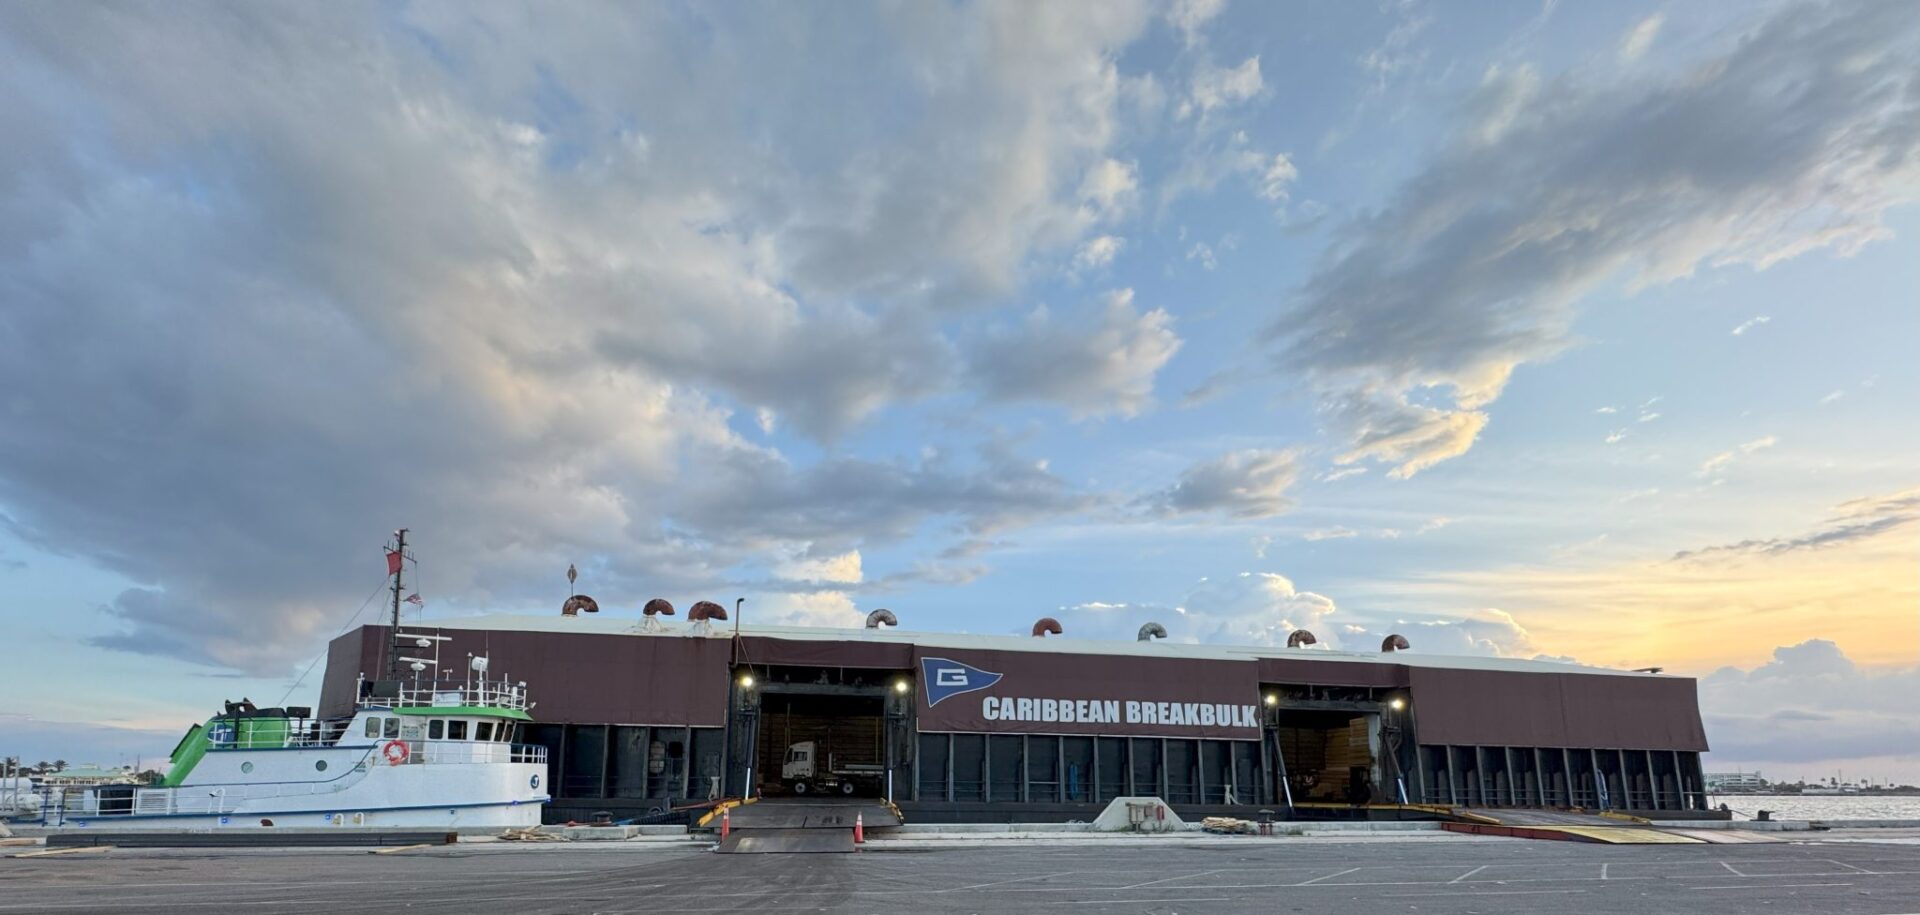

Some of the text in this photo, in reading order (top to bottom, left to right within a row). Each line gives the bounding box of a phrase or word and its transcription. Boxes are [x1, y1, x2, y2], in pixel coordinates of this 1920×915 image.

[936, 668, 969, 686] G
[982, 697, 1258, 728] CARIBBEAN BREAKBULK
